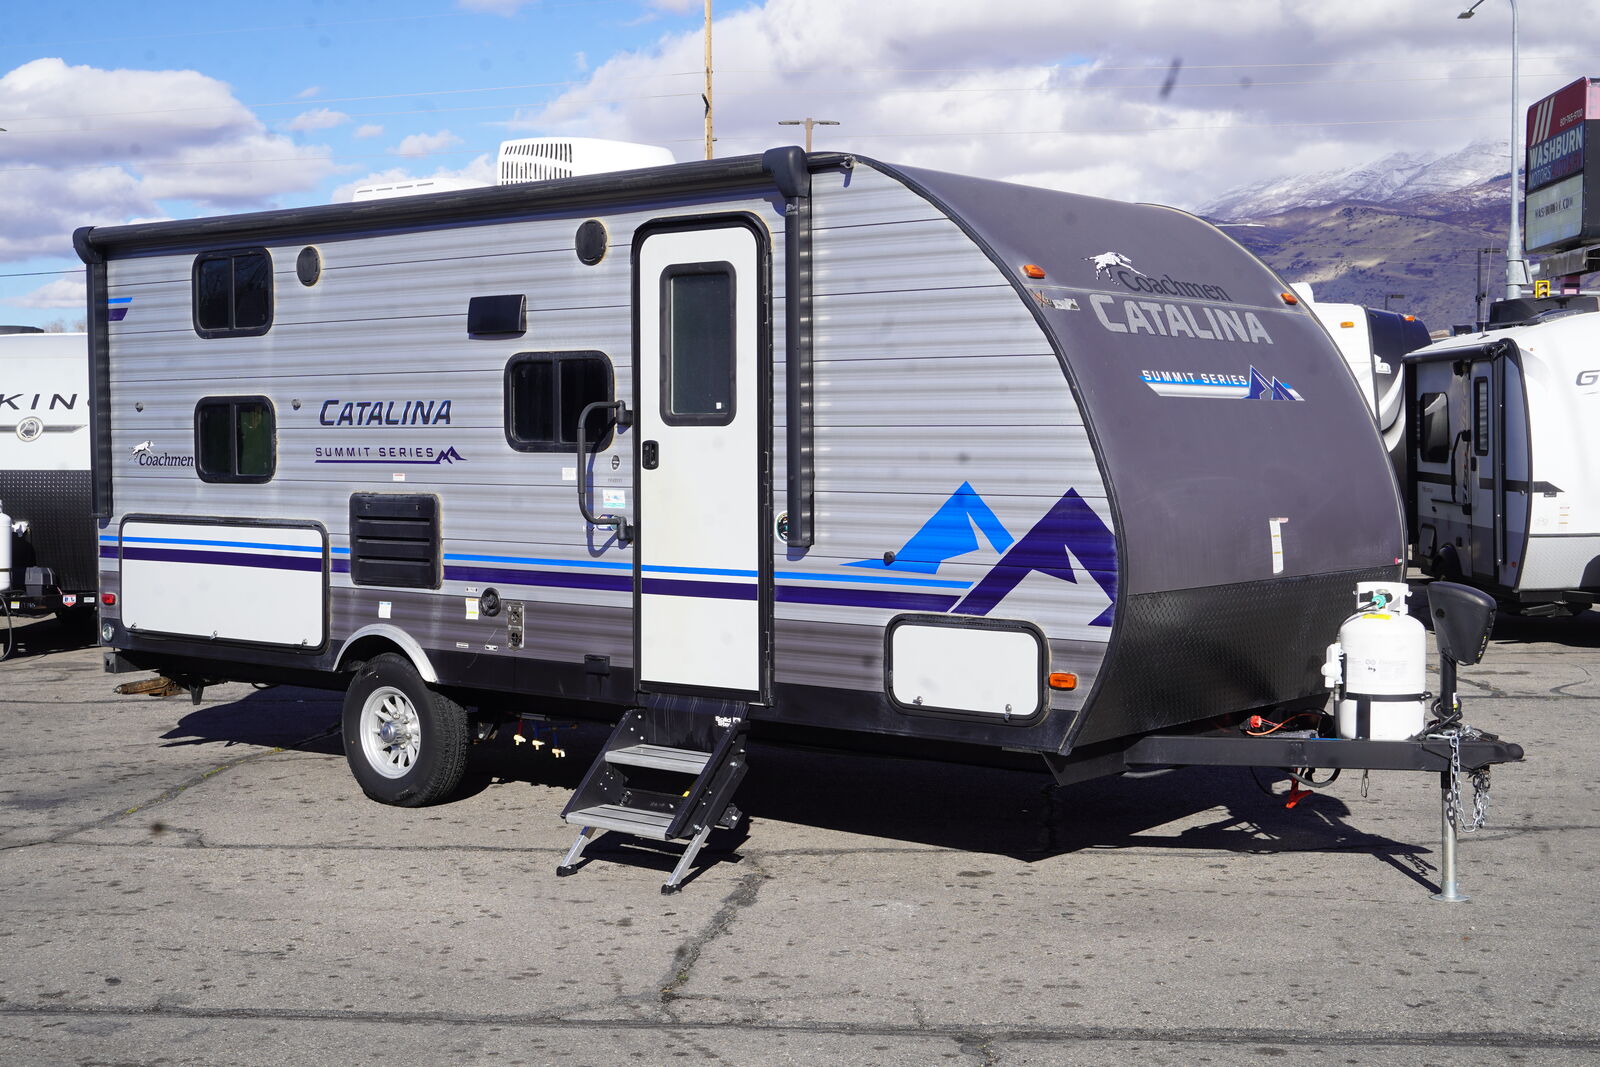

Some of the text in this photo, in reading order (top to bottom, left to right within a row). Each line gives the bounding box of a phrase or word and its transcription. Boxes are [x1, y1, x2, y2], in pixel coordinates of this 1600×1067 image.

[1530, 125, 1583, 170] WASHBURN
[1117, 270, 1233, 302] Coachmen
[1089, 293, 1274, 345] CATALINA
[1142, 369, 1248, 386] SUMMIT SERIES
[0, 393, 90, 410] KIN
[319, 399, 452, 426] CATALINA
[139, 452, 194, 467] Coachmen
[315, 447, 434, 458] SUMMIT SERIES
